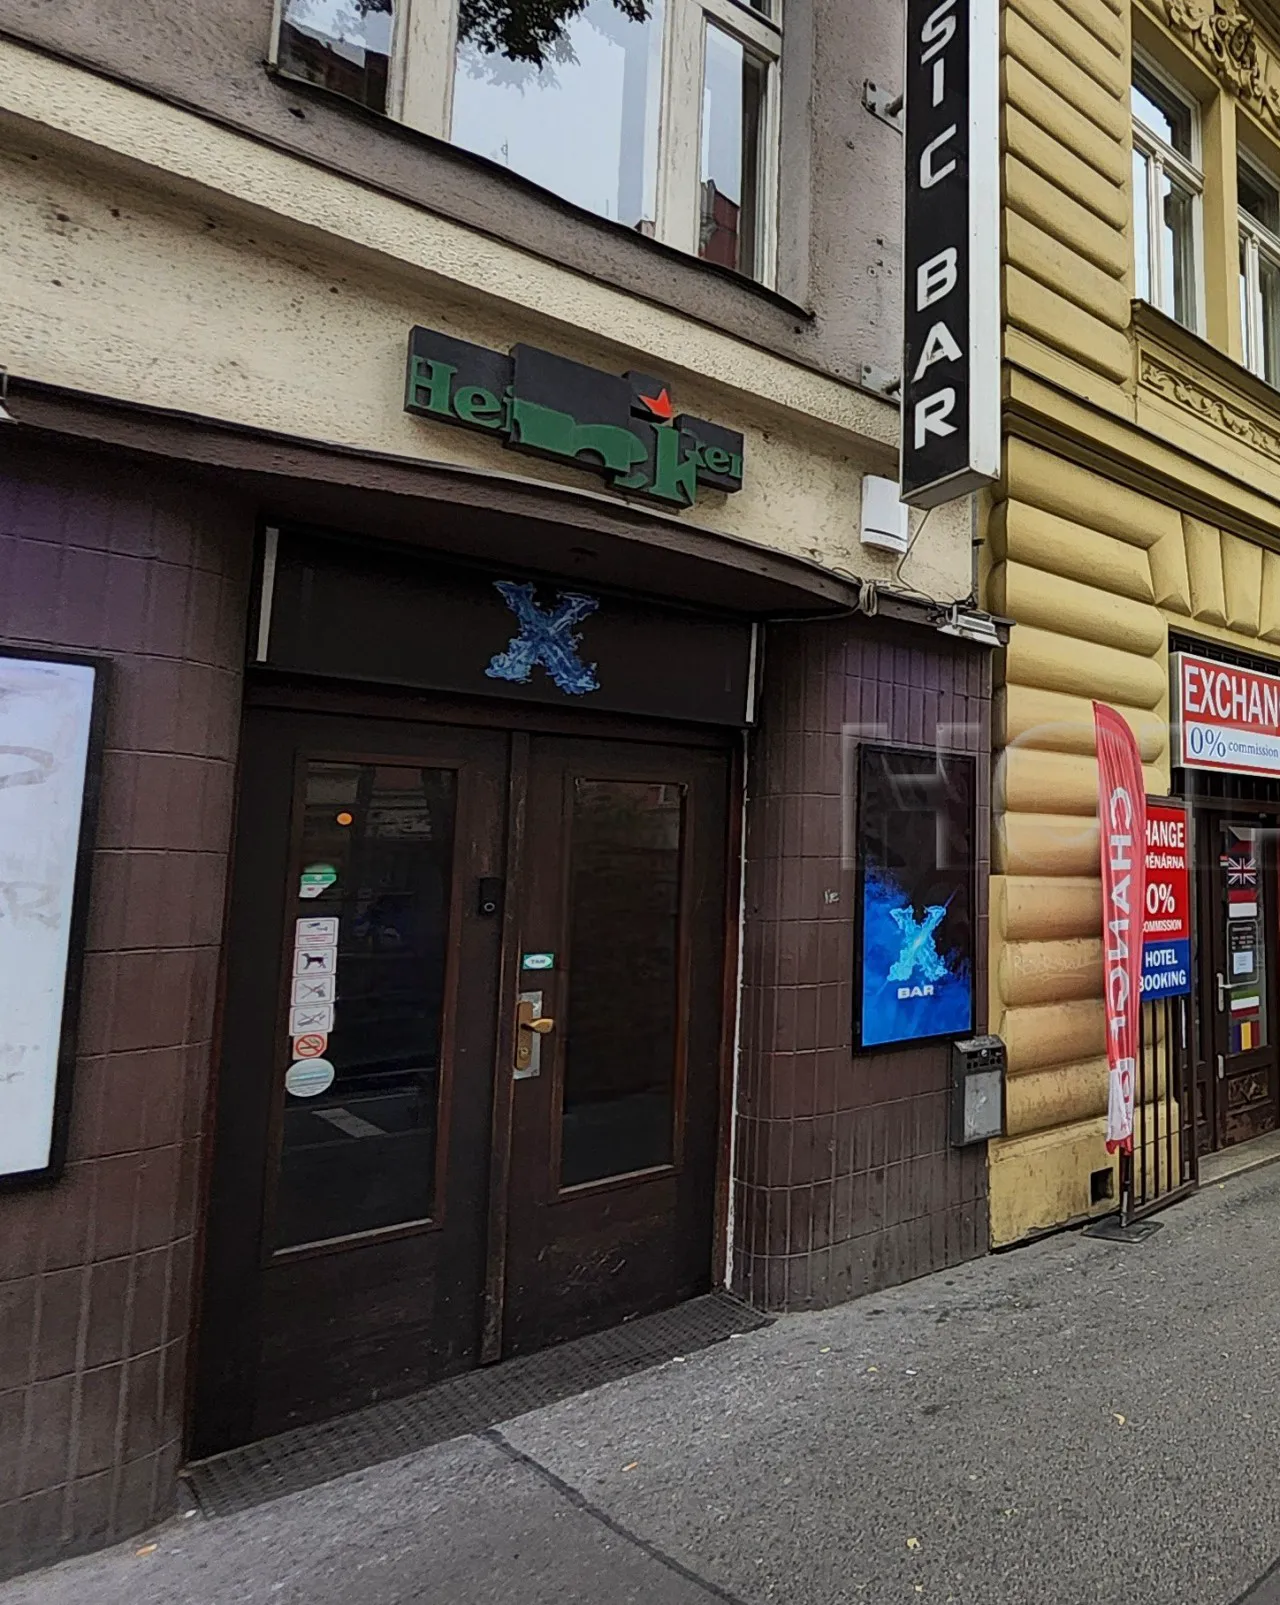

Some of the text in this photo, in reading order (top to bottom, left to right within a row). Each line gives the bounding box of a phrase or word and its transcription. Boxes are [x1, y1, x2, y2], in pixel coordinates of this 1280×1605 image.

[911, 247, 960, 450] BAR
[1190, 727, 1226, 758] 0%
[1229, 741, 1279, 758] commission
[1145, 819, 1185, 848] HANGE
[1146, 883, 1175, 914] 0%
[1145, 949, 1179, 967] HOTEL
[898, 984, 934, 999] BAR
